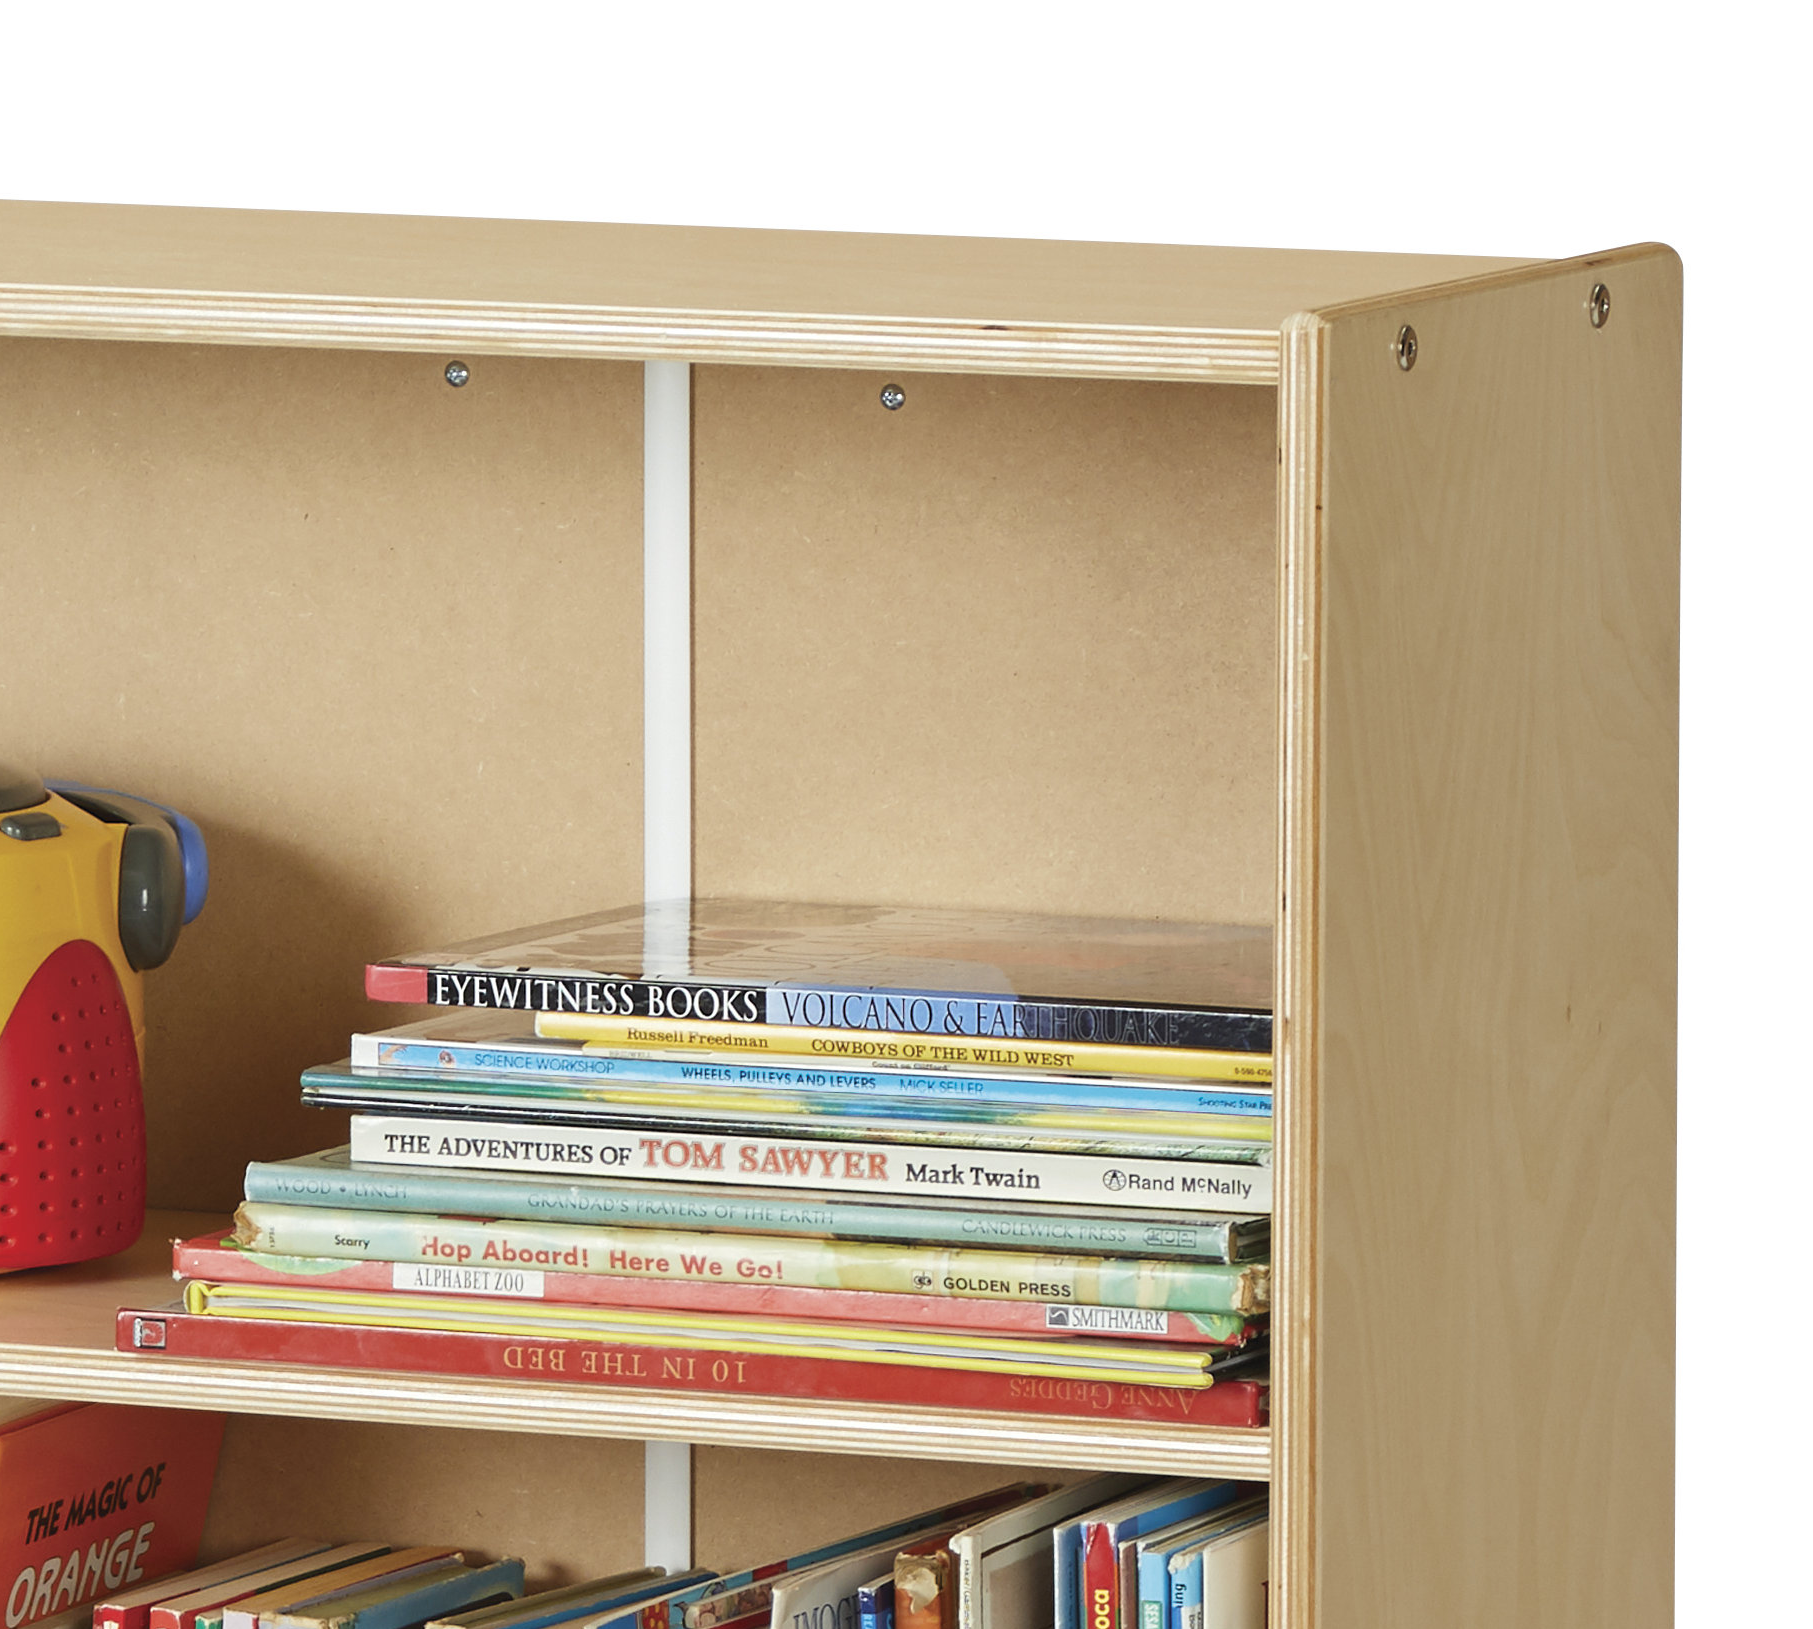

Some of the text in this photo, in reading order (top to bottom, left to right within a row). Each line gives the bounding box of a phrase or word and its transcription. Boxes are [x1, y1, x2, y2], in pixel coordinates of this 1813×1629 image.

[435, 974, 758, 1022] EYEWITNESS BOOKS
[782, 991, 1179, 1045] VOLCANO & EARTHQUAKE
[627, 1028, 768, 1048] Russell Freedman
[811, 1040, 1074, 1067] COWBOYS OF THE WILD WEST
[385, 1134, 888, 1182] THE ADVENTURES OF TOM SAWYER
[906, 1163, 1040, 1190] Mark Twain
[1128, 1174, 1174, 1192] Rand
[421, 1235, 783, 1280] Hop Aboard! Here We Go!
[415, 1268, 523, 1292] ALPHABET ZOO
[1071, 1307, 1165, 1331] SMITHMARK
[503, 1346, 747, 1383] 10 IN THE BED
[25, 1463, 166, 1544] THE MAGIC OF
[5, 1521, 155, 1628] ORANGE
